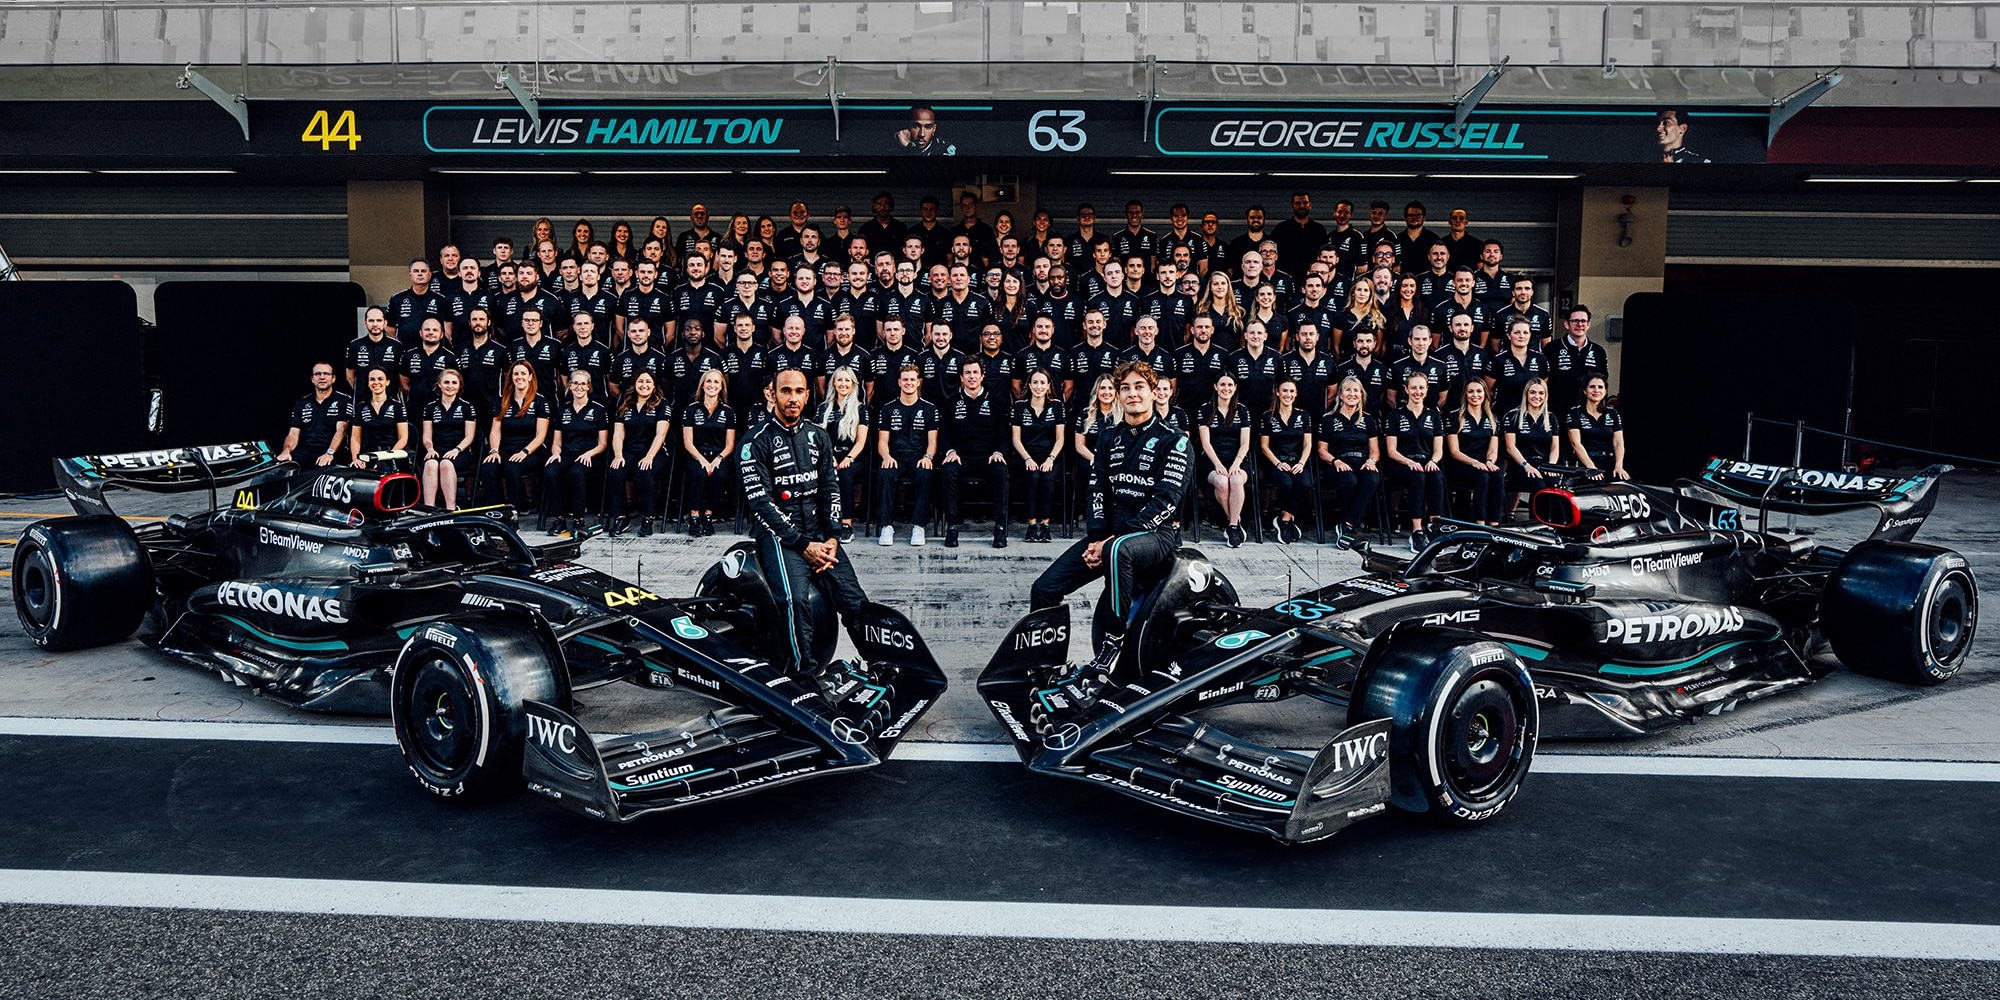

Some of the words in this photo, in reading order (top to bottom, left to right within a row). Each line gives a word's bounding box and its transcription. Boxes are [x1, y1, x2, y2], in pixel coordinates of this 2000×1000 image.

[301, 110, 362, 150] 44
[473, 118, 583, 144] LEWIS
[586, 118, 783, 144] HAMILTON
[1028, 109, 1087, 152] 63
[1210, 120, 1363, 148] GEORGE
[1364, 121, 1525, 149] RUSSELL
[100, 443, 247, 469] PETROAS
[774, 470, 819, 486] PETRON
[1730, 461, 1887, 491] PETONAS
[236, 490, 254, 510] 44
[312, 474, 353, 504] INEOS
[1143, 503, 1176, 530] INEOS
[1603, 493, 1651, 519] INEOS
[1718, 509, 1737, 531] 63
[268, 530, 324, 554] TeamViewer
[1644, 552, 1703, 573] TeamViewer
[217, 581, 349, 624] PETRONAS
[604, 586, 659, 608] 44
[1274, 599, 1337, 620] 63
[1422, 609, 1481, 627] AMG
[1599, 606, 1744, 645] PETRONAS
[425, 627, 458, 649] PIRELLI
[865, 625, 915, 651] INEOS
[1015, 626, 1067, 650] INEOS
[1471, 648, 1505, 667] PIRELLI
[651, 674, 672, 687] FIA
[677, 667, 720, 690] Einhell
[1198, 681, 1244, 701] Einhell
[1256, 686, 1278, 699] FIA
[527, 713, 576, 754] IWC
[618, 747, 685, 770] PETRONAS
[1333, 731, 1388, 773] IWC
[625, 763, 694, 787] Syntium
[699, 765, 817, 798] TeamViewer
[1228, 758, 1293, 786] PETRONAS
[1110, 776, 1230, 816] TeamViewer
[1217, 774, 1288, 802] Syntium
[1454, 800, 1506, 821] ZERO
